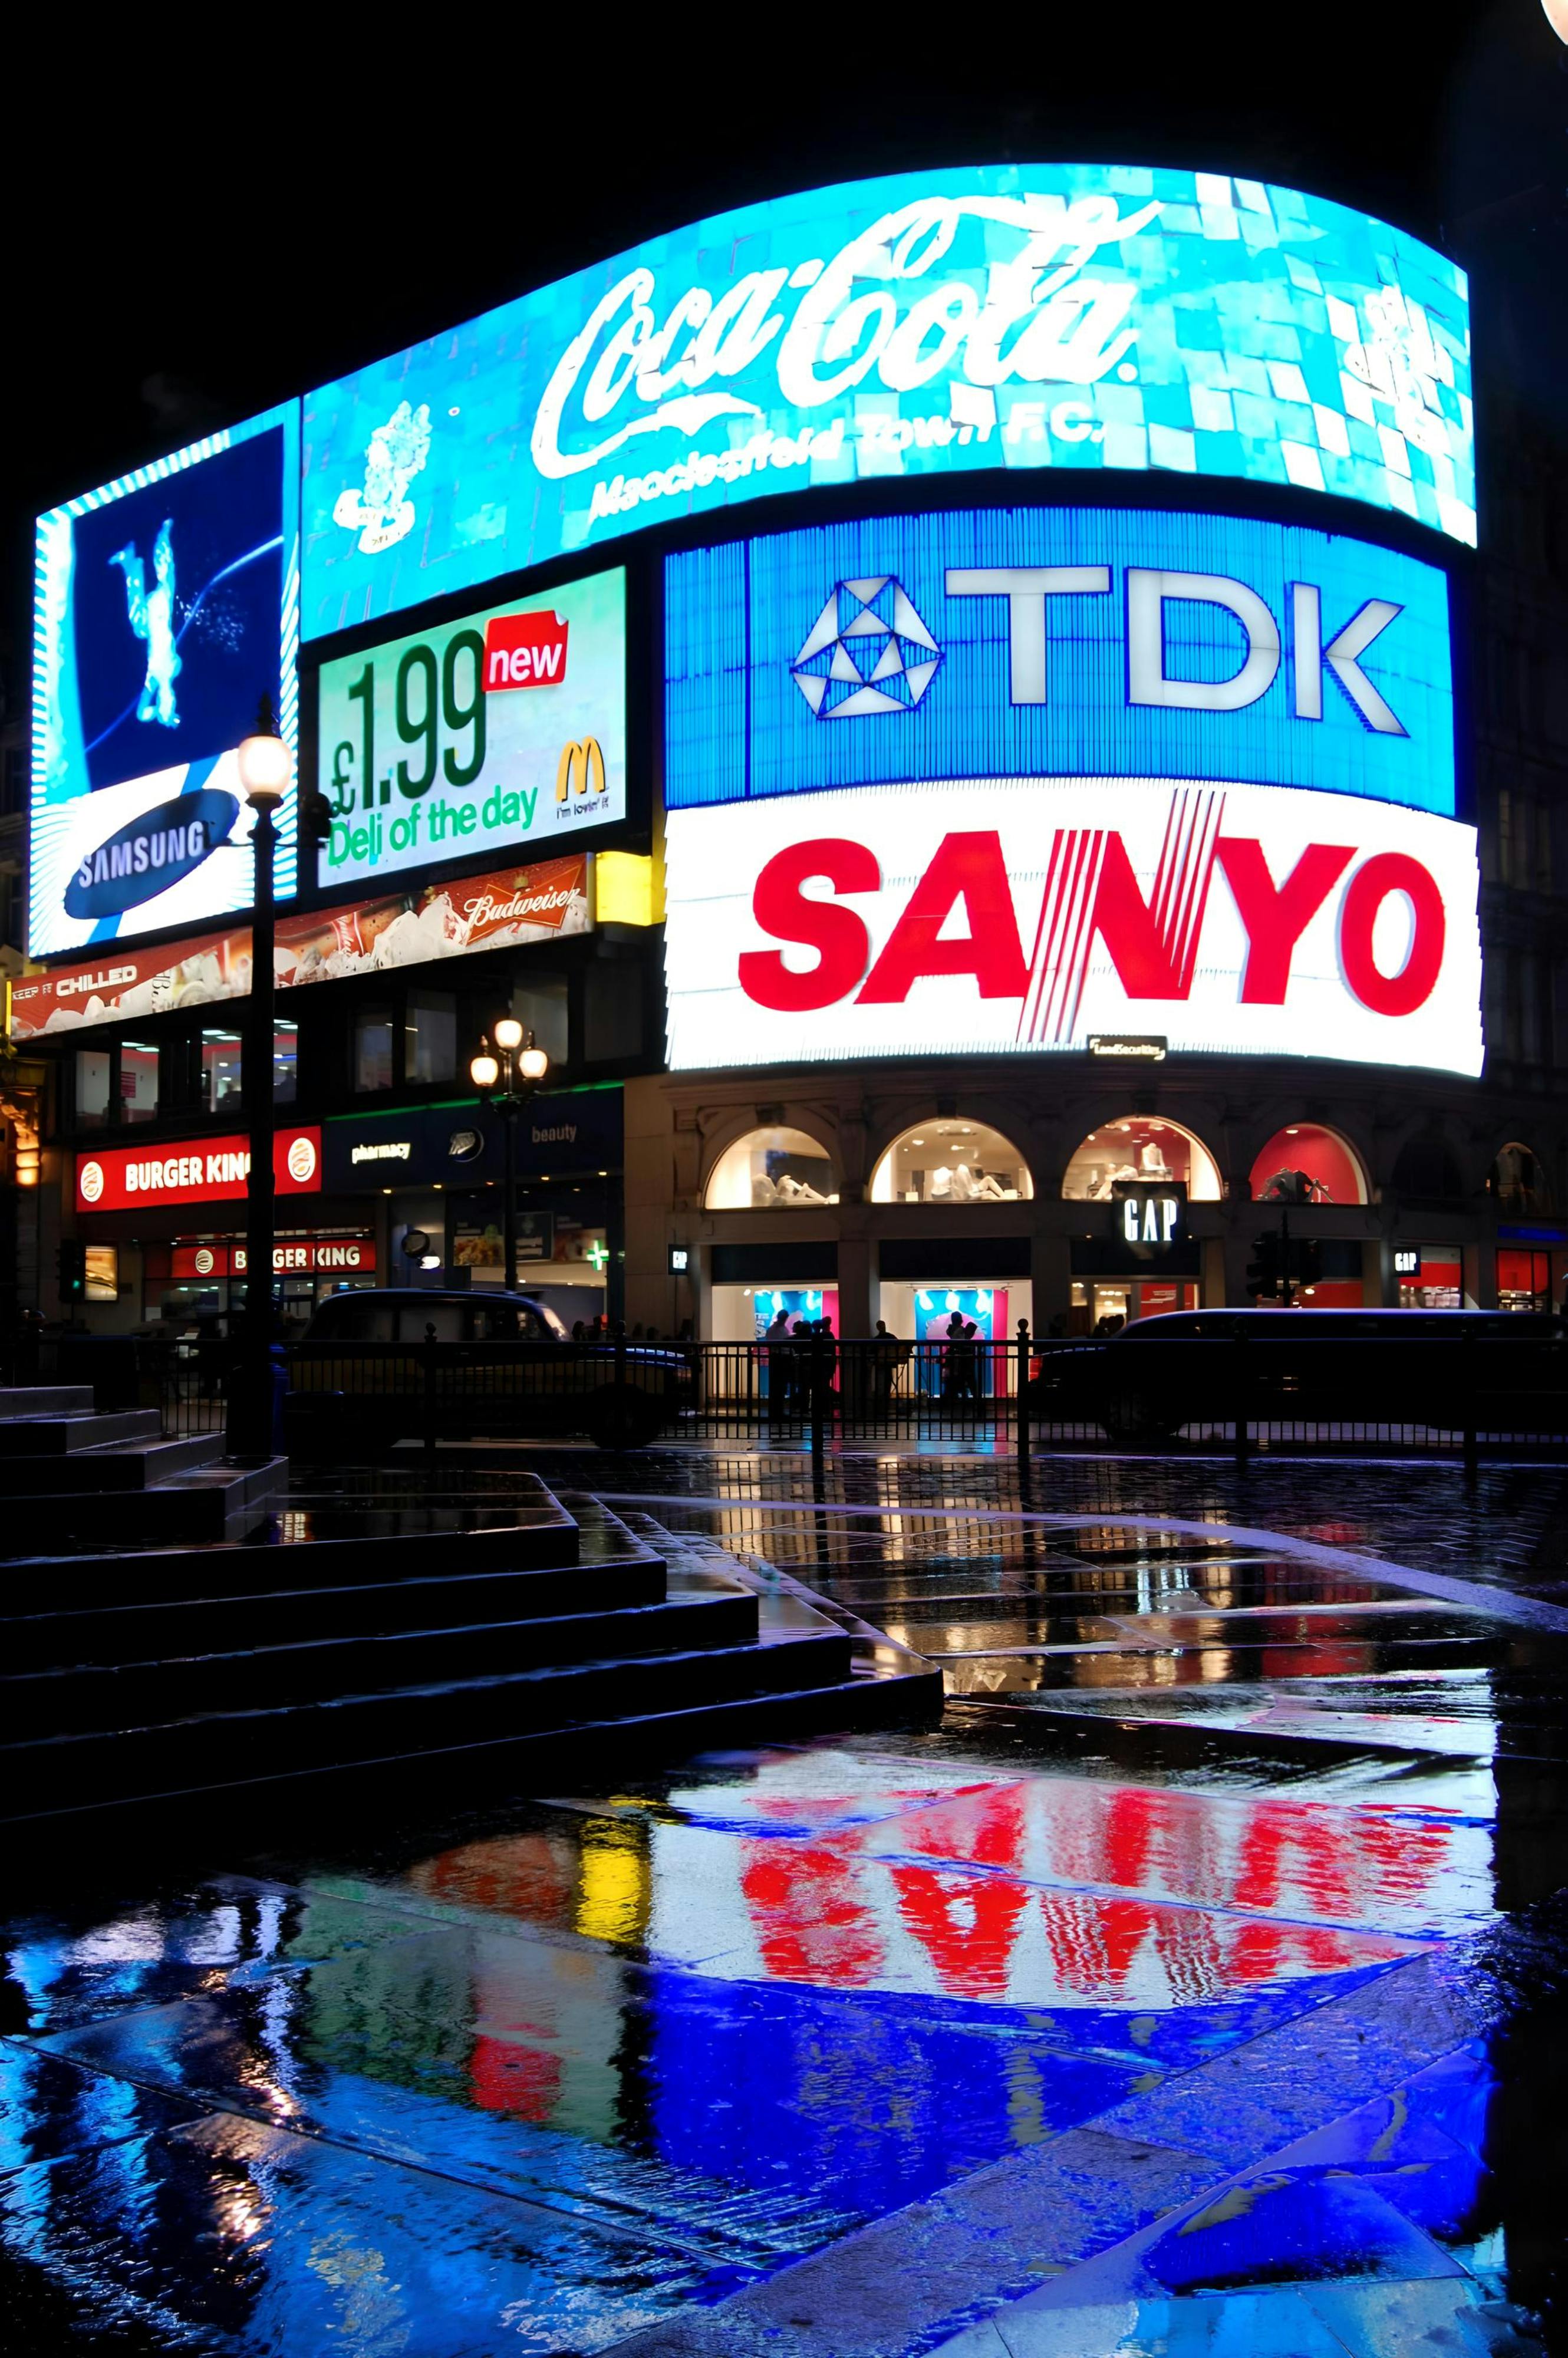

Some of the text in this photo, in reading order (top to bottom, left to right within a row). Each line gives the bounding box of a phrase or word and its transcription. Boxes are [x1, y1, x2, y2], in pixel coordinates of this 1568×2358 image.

[531, 196, 1165, 479] Coca-Cola
[489, 643, 563, 684] new
[944, 565, 1411, 739] TDK
[331, 628, 486, 819] £1.99
[327, 784, 538, 867] Deli of the day
[78, 821, 205, 888] SAMSUNG
[464, 885, 581, 928] Budweiser
[738, 788, 1446, 1043] SANYO
[57, 965, 137, 997] CHILLED
[352, 1143, 411, 1164] pharmacy
[532, 1124, 577, 1143] beauty
[126, 1156, 204, 1192] BURGER
[1124, 1198, 1177, 1241] GAP
[235, 1246, 361, 1269] BGER KING
